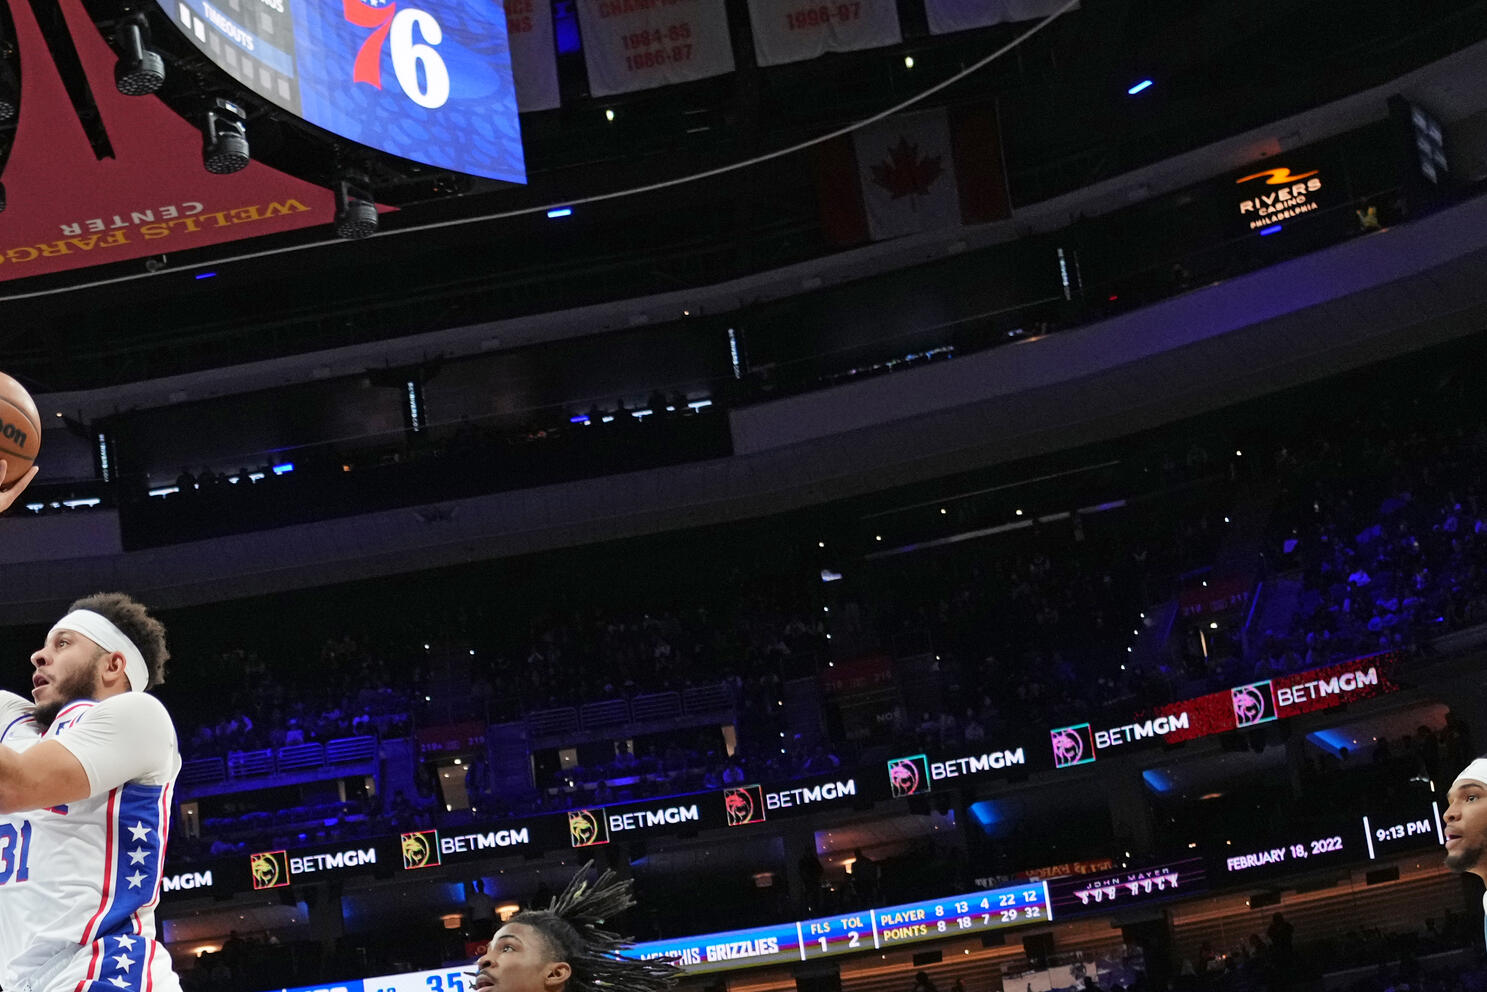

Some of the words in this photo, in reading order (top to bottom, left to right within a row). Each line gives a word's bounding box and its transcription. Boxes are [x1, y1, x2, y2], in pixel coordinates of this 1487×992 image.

[202, 1, 254, 51] TIMEOUTS
[1240, 178, 1322, 214] RIVERS
[1258, 195, 1306, 216] CASINO
[59, 201, 205, 237] CENTER
[141, 198, 313, 240] WELLS
[1250, 202, 1318, 230] PHILADELPHIA
[1277, 667, 1378, 706] BETMGM
[1094, 712, 1189, 750] BETMGM
[930, 747, 1025, 781] BETMGM
[767, 779, 856, 810] BETMGM
[609, 804, 699, 832] BETMGM
[1376, 825, 1405, 842] 9:13
[1407, 818, 1431, 836] PM
[441, 828, 529, 854] BETMGM
[1226, 847, 1285, 872] FEBRUARY
[1311, 836, 1343, 856] 2022
[291, 848, 376, 874] BETMGM
[163, 870, 213, 892] MGM
[881, 911, 925, 927] PLAYER
[935, 906, 944, 916] 8
[954, 902, 969, 914] 13
[980, 898, 989, 909] 4
[999, 894, 1016, 907] 22
[1022, 890, 1037, 902] 12
[883, 924, 928, 941] POINTS
[937, 920, 946, 932] 8
[956, 917, 971, 929] 18
[981, 914, 990, 925] 7
[1001, 910, 1017, 922] 29
[1025, 906, 1041, 918] 32
[810, 921, 831, 935] FLS
[840, 917, 863, 931] TOL
[706, 937, 779, 962] GRIZZLIES
[818, 937, 828, 953] 1
[848, 931, 860, 948] 2
